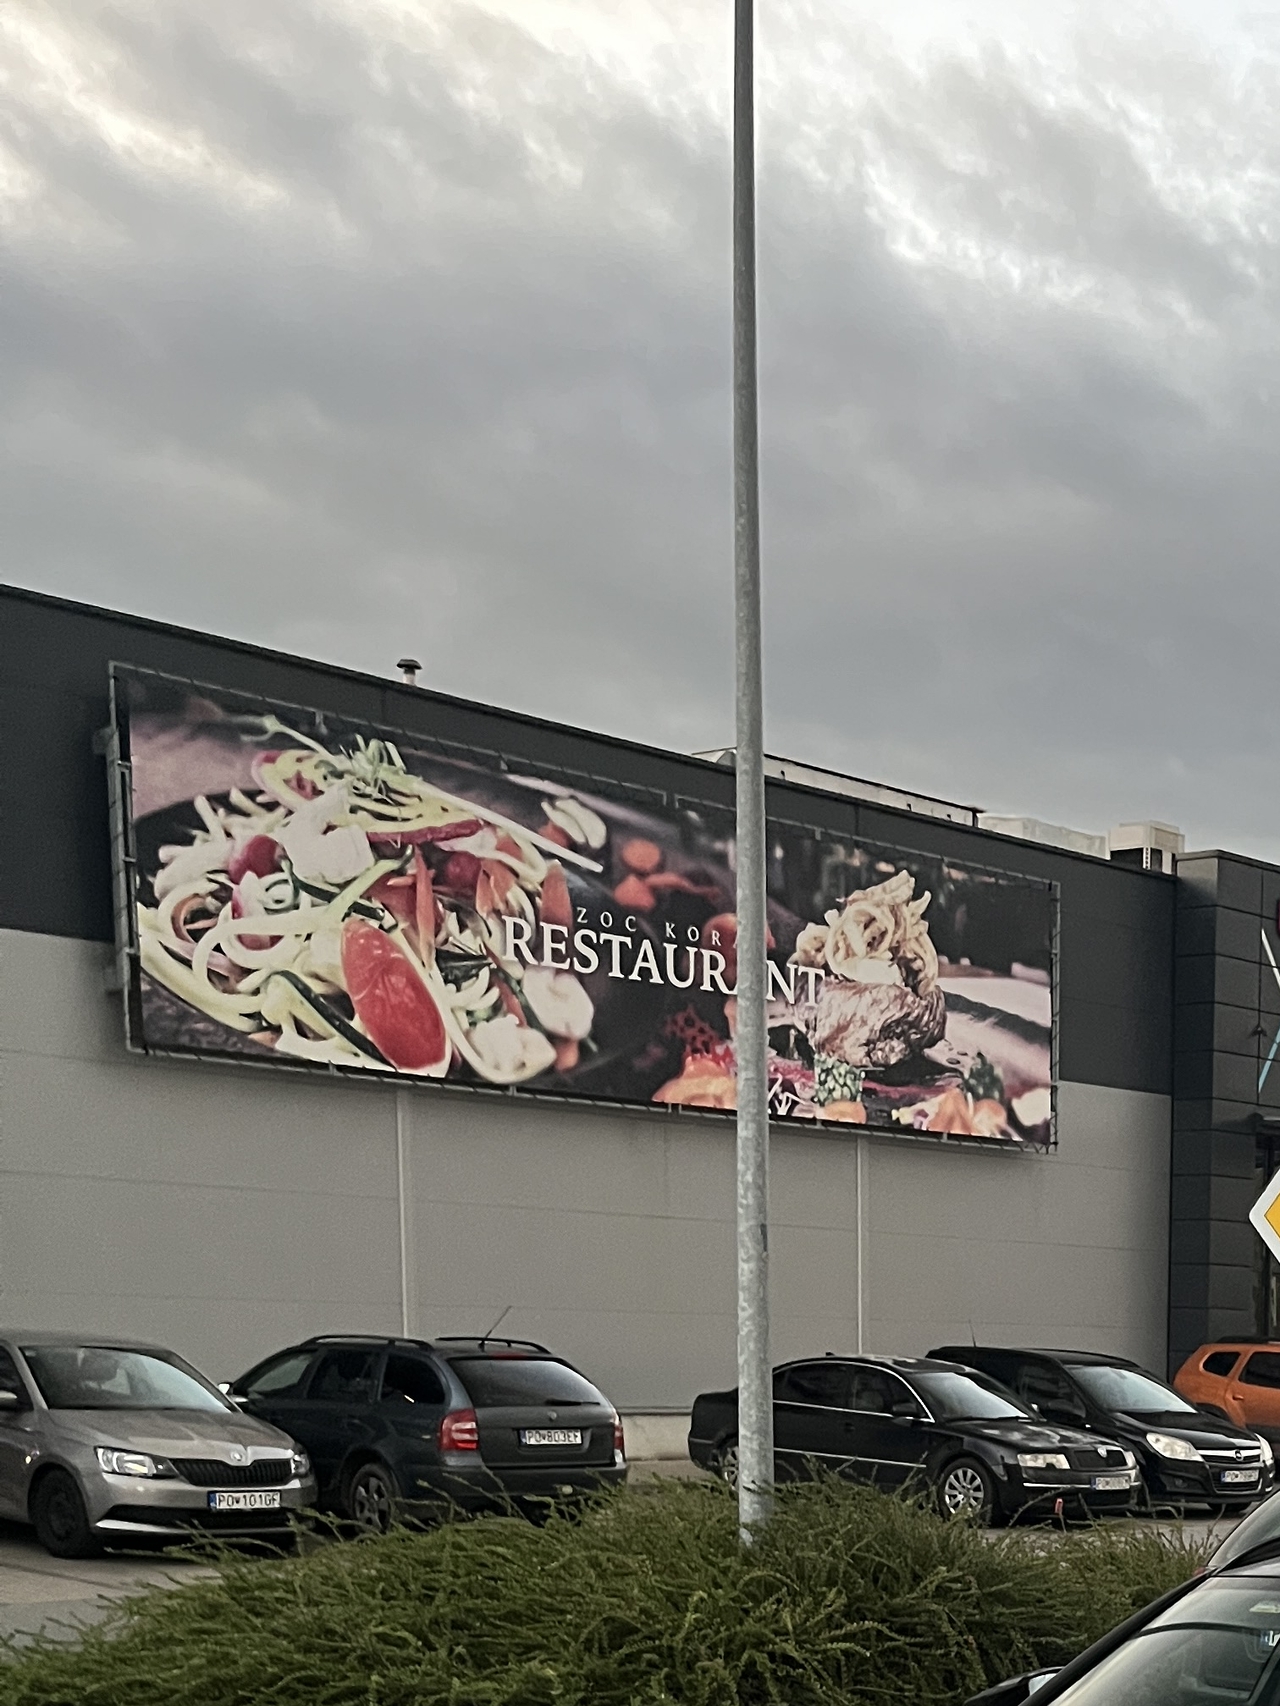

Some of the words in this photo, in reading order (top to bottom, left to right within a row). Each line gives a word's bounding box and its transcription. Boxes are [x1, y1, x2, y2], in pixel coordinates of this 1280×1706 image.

[501, 914, 827, 1008] RESTAURNT
[577, 907, 637, 932] ZOC
[665, 922, 738, 948] KOR
